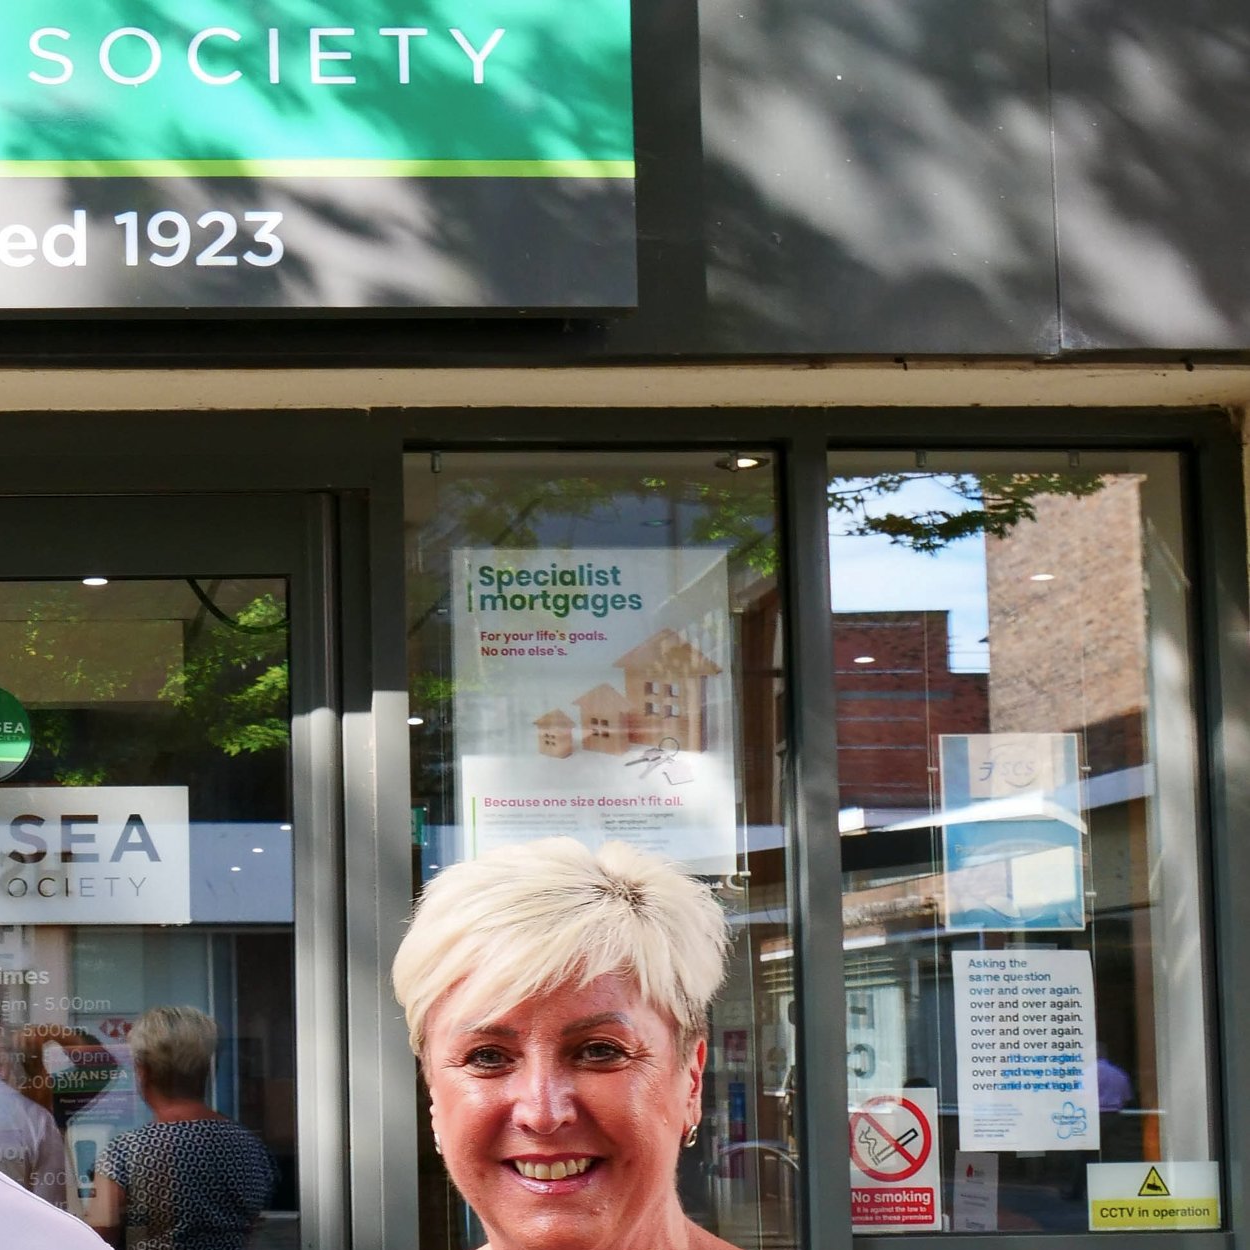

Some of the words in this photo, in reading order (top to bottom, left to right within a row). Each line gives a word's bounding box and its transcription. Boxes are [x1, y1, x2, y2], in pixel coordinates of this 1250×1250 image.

[29, 27, 508, 86] SOCIETY
[114, 211, 285, 269] 1923
[479, 563, 621, 593] Specialist
[480, 590, 642, 618] mortgages
[480, 631, 500, 641] For
[504, 632, 533, 644] your
[536, 630, 566, 641] life's
[569, 630, 607, 644] goals.
[481, 646, 498, 656] No
[501, 648, 525, 656] one
[528, 645, 568, 656] else's.
[484, 797, 540, 808] Because
[543, 798, 567, 807] one
[570, 795, 594, 807] size
[597, 795, 646, 807] doesn't
[648, 795, 662, 806] fit
[968, 958, 1006, 970] Asking
[1009, 959, 1027, 968] the
[969, 973, 1000, 982] same
[1003, 971, 1051, 983] question
[998, 986, 1018, 995] and
[1050, 985, 1081, 996] again.
[45, 996, 111, 1013] 5.00pm
[998, 1000, 1018, 1008] and
[1050, 999, 1082, 1010] again.
[999, 1014, 1018, 1022] and
[1022, 1014, 1046, 1022] over
[1050, 1012, 1082, 1024] again.
[23, 1023, 88, 1039] 5.00pm
[971, 1028, 995, 1036] over
[999, 1027, 1019, 1036] and
[1051, 1026, 1083, 1037] again.
[1000, 1041, 1019, 1049] and
[1051, 1040, 1083, 1051] again.
[972, 1055, 996, 1063] over
[57, 1070, 128, 1080] SWANSEA
[18, 1074, 85, 1091] 2:00pm
[852, 1191, 870, 1203] No
[874, 1190, 931, 1205] smoking
[1100, 1207, 1134, 1218] CCTV
[1138, 1207, 1149, 1217] in
[1153, 1206, 1210, 1219] operation
